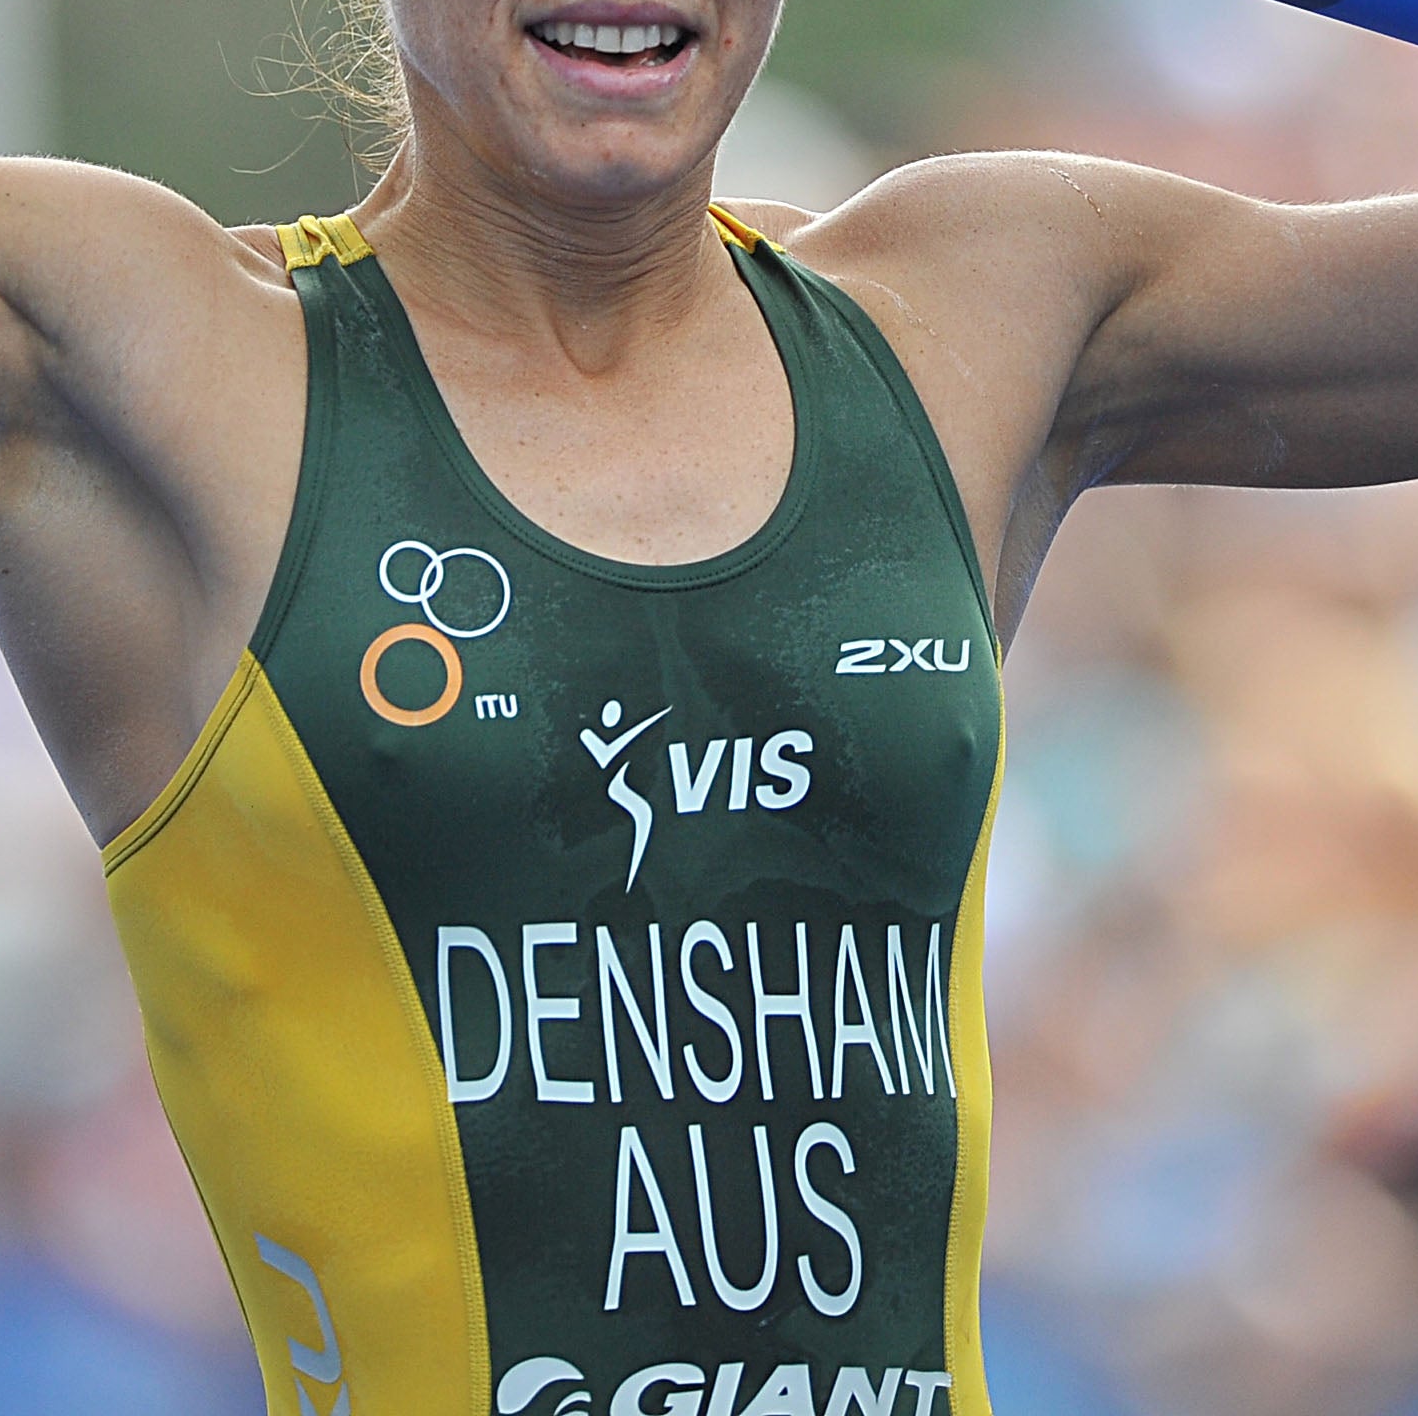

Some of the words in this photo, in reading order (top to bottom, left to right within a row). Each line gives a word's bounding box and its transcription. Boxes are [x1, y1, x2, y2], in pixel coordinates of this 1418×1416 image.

[835, 638, 971, 674] 2XU
[474, 693, 519, 720] ITU
[668, 729, 814, 814] VIS
[437, 920, 957, 1104] DENSHAM
[603, 1121, 863, 1317] AUS
[608, 1361, 952, 1416] GIANT
